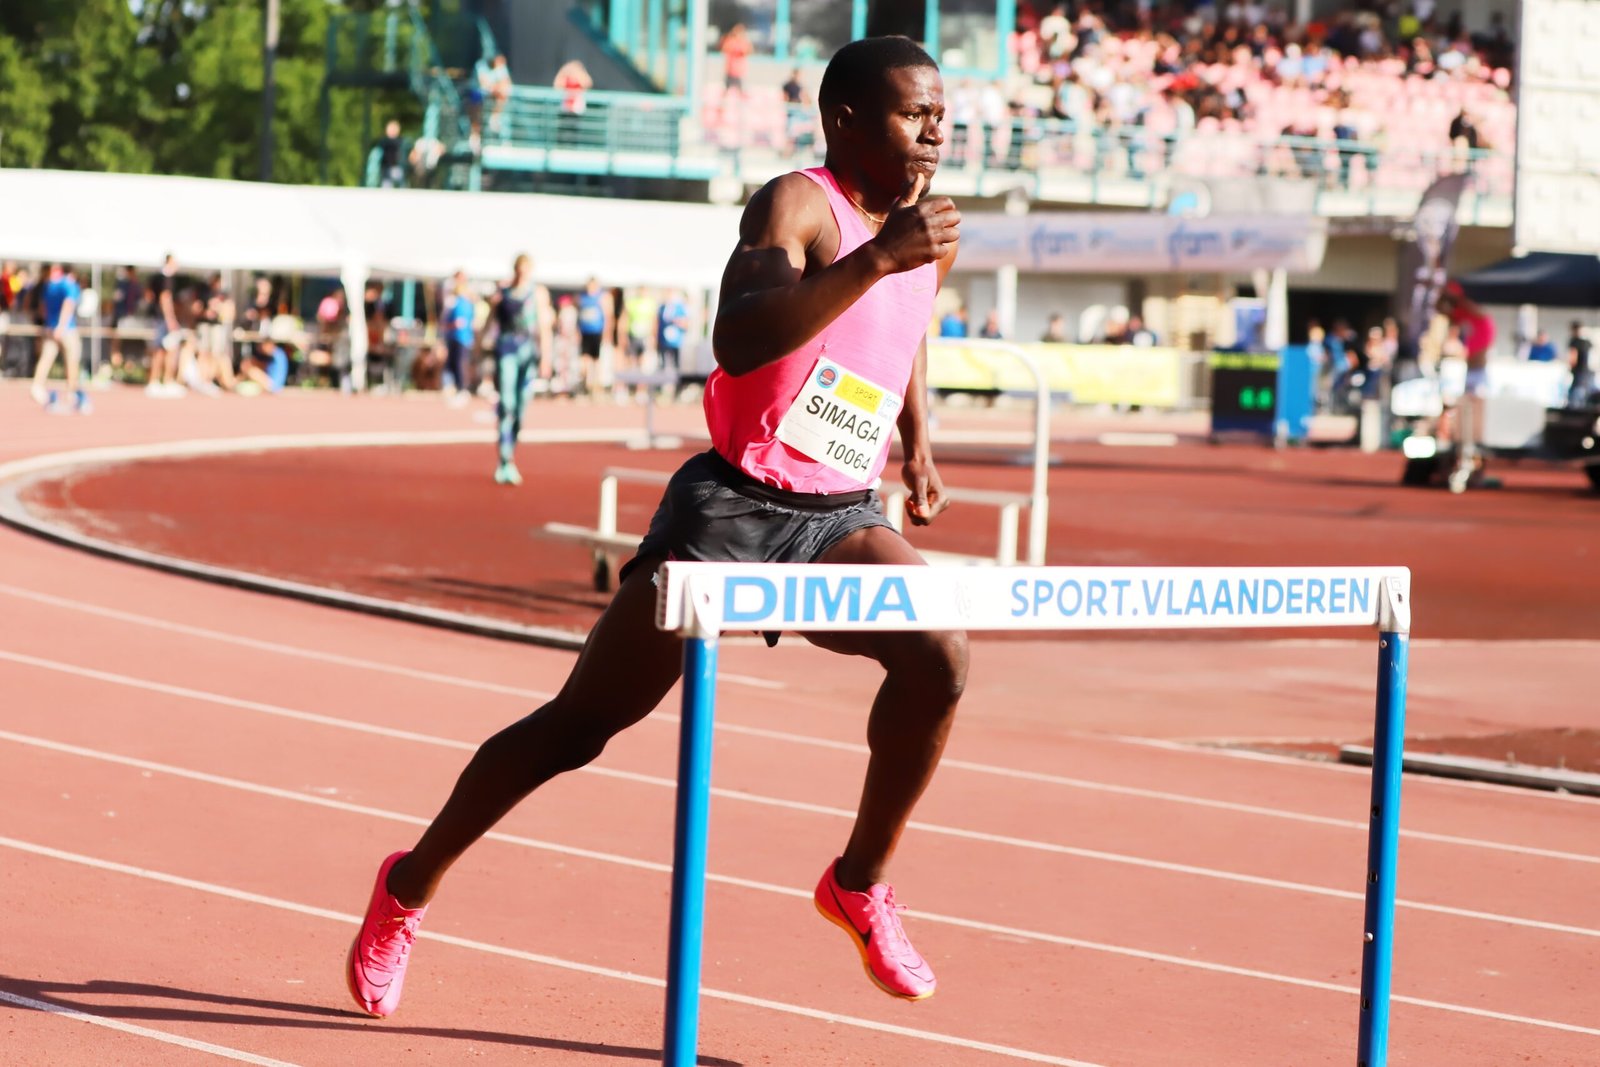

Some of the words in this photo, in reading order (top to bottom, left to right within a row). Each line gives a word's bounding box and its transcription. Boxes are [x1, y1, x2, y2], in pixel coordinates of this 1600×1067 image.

[806, 395, 881, 446] SIMAGA
[826, 440, 871, 472] 10064
[722, 576, 918, 622] DIMA
[1010, 577, 1370, 617] SPORT.VLAANDEREN
